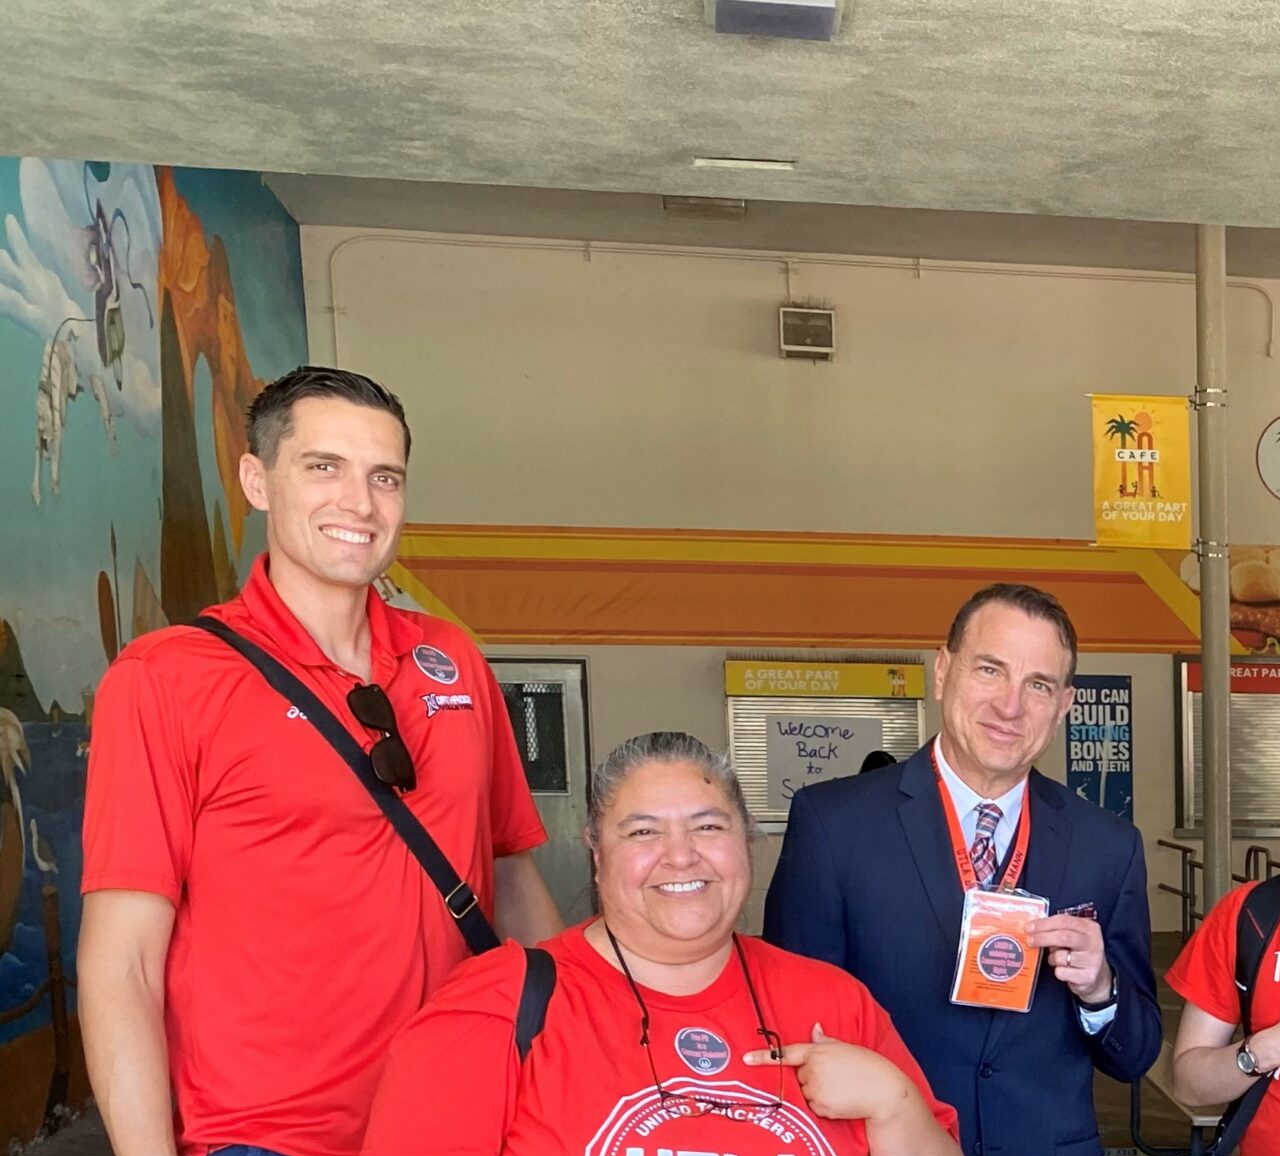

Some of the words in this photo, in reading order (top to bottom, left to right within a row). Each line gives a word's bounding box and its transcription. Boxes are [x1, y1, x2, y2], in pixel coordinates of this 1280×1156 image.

[1117, 451, 1158, 460] CAFE
[1102, 501, 1110, 510] A
[1113, 501, 1155, 511] GREAT
[1157, 502, 1188, 513] PART
[1102, 511, 1119, 521] OF
[1121, 511, 1156, 522] YOUR
[1158, 512, 1184, 522] DAY
[744, 670, 754, 680] A
[757, 670, 802, 681] GREAT
[806, 670, 841, 681] PART
[1230, 667, 1259, 678] REAT
[745, 680, 764, 690] OF
[767, 680, 807, 691] YOUR
[811, 681, 840, 691] DAY
[1101, 689, 1129, 703] CAN
[1070, 704, 1129, 725] BUILD
[777, 721, 855, 740] Welcome
[1070, 725, 1129, 741] STRONG
[1070, 741, 1130, 760] BONES
[806, 762, 822, 774] to
[1071, 761, 1094, 772] AND
[1096, 761, 1130, 772] TEETH
[957, 848, 972, 874] UTLA
[635, 1104, 692, 1137] UNITED
[695, 1102, 796, 1144] TEACHERS
